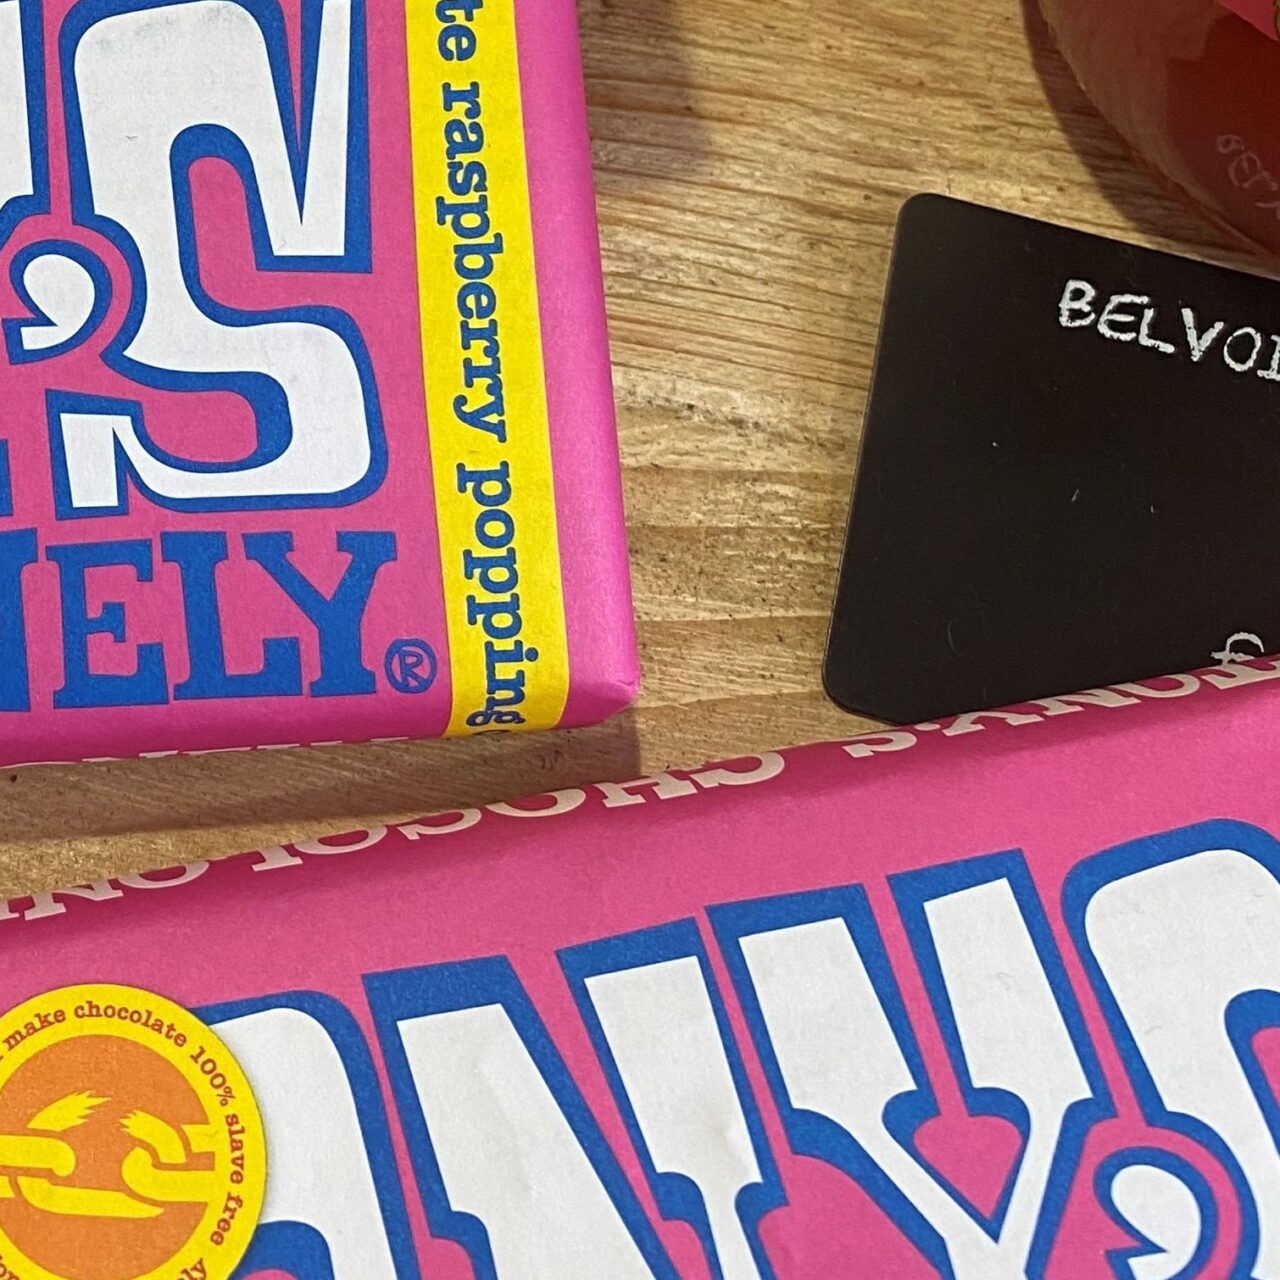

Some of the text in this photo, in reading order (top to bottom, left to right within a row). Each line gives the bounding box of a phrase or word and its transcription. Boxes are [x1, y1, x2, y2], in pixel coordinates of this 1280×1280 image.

[435, 81, 508, 444] raspberry
[455, 460, 539, 728] popping
[2, 1006, 67, 1052] make
[73, 999, 188, 1048] chocolate
[189, 1044, 236, 1108] 100%
[224, 1112, 247, 1186] slave
[209, 1191, 244, 1248] free
